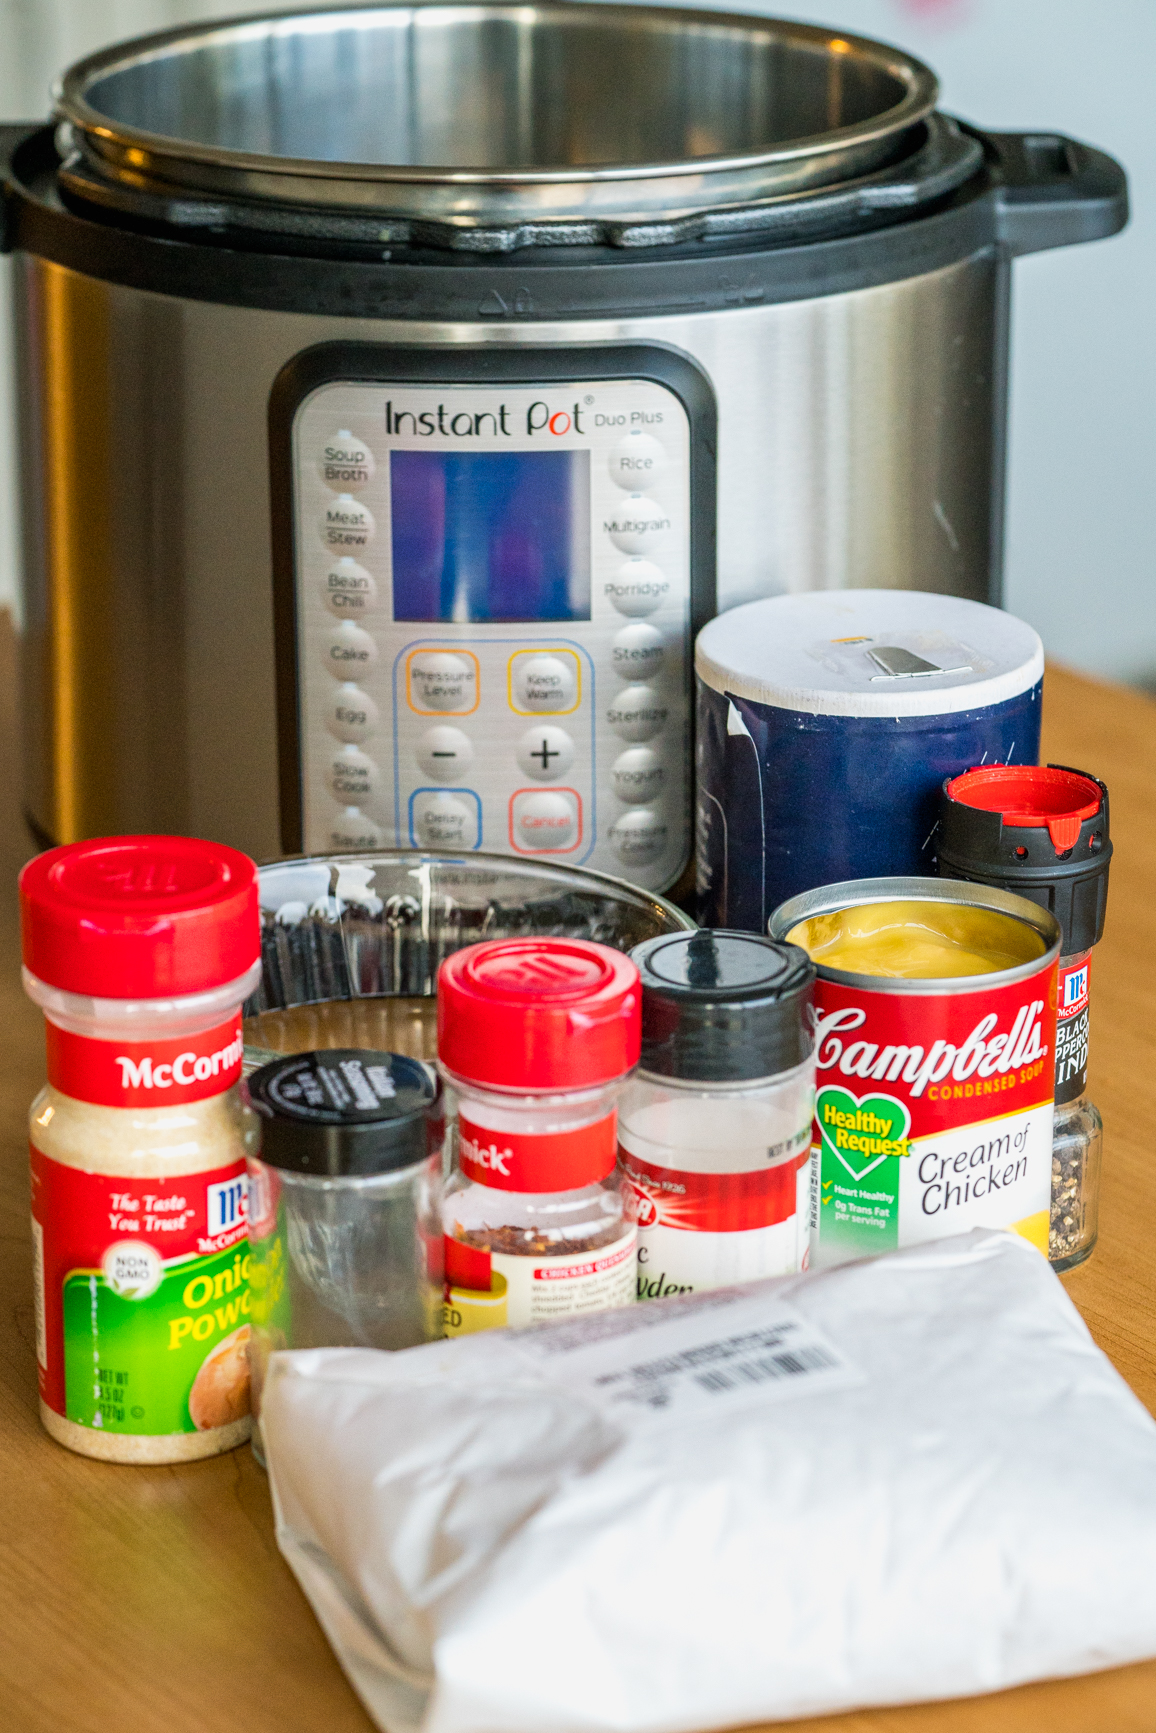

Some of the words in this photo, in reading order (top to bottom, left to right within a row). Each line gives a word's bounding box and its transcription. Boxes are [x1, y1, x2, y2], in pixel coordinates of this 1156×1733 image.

[385, 400, 511, 436] Instant
[527, 401, 585, 436] Pot
[594, 413, 626, 428] Duo
[630, 411, 664, 425] Plus
[324, 447, 365, 466] Soup
[620, 456, 653, 470] Rice
[324, 467, 368, 482] Broth
[327, 511, 365, 525] Meat
[603, 517, 671, 535] Multigrain
[327, 532, 367, 546] Stew
[328, 574, 368, 589] Bean
[604, 582, 670, 599] Porridge
[330, 646, 369, 660] Cake
[613, 646, 664, 660] Steam
[412, 668, 474, 682] Pressure
[527, 674, 561, 688] Keep
[424, 685, 462, 697] Level
[335, 709, 366, 725] Egg
[521, 814, 570, 830] Cancel
[928, 1077, 1016, 1101] CONDENSED
[1020, 1062, 1045, 1084] SOUP
[824, 1104, 893, 1137] Healthy
[836, 1128, 912, 1157] Request
[918, 1137, 1010, 1184] Cream
[1014, 1122, 1031, 1153] of
[922, 1156, 1028, 1215] Chicken
[834, 1184, 858, 1198] Heart
[859, 1189, 895, 1204] Healthy
[110, 1193, 140, 1212] The
[142, 1195, 187, 1212] Taste
[834, 1200, 847, 1212] 0g
[848, 1202, 872, 1216] Trans
[874, 1206, 890, 1217] Fat
[108, 1213, 141, 1232] You
[142, 1213, 187, 1232] Trust
[835, 1212, 849, 1222] per
[851, 1214, 886, 1229] serving
[116, 1257, 148, 1267] NON
[116, 1269, 149, 1280] GMO
